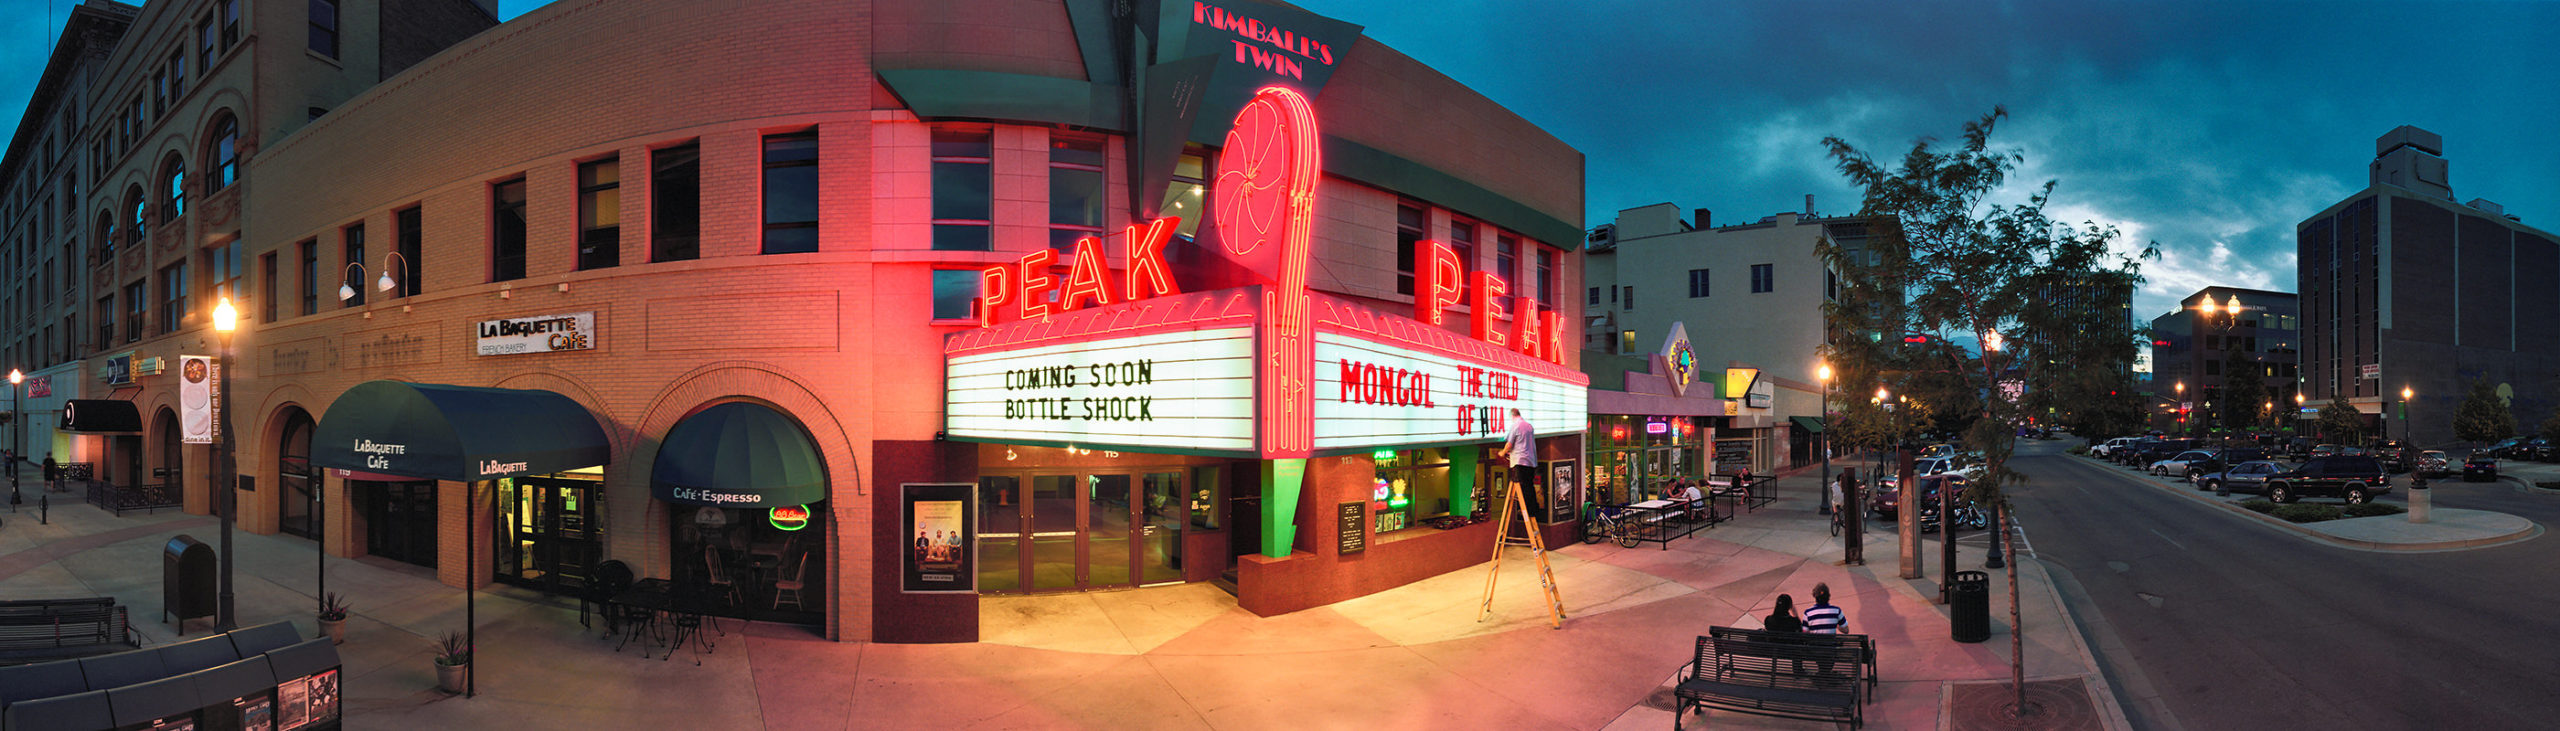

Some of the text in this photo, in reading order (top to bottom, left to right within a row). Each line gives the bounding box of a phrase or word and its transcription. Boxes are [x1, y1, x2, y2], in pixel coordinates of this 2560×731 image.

[1194, 1, 1333, 65] KIMBALL'S
[1231, 40, 1302, 81] TWIN
[981, 216, 1182, 328] PEAK
[1415, 240, 1566, 366] PEAK
[482, 343, 527, 354] FRENCH BAKERY
[1006, 359, 1152, 390] COMING SOON
[1340, 358, 1519, 408] MONGOL THE CHILD
[1006, 396, 1153, 421] BOTTLE SHOCK
[1458, 404, 1506, 437] OF HUA
